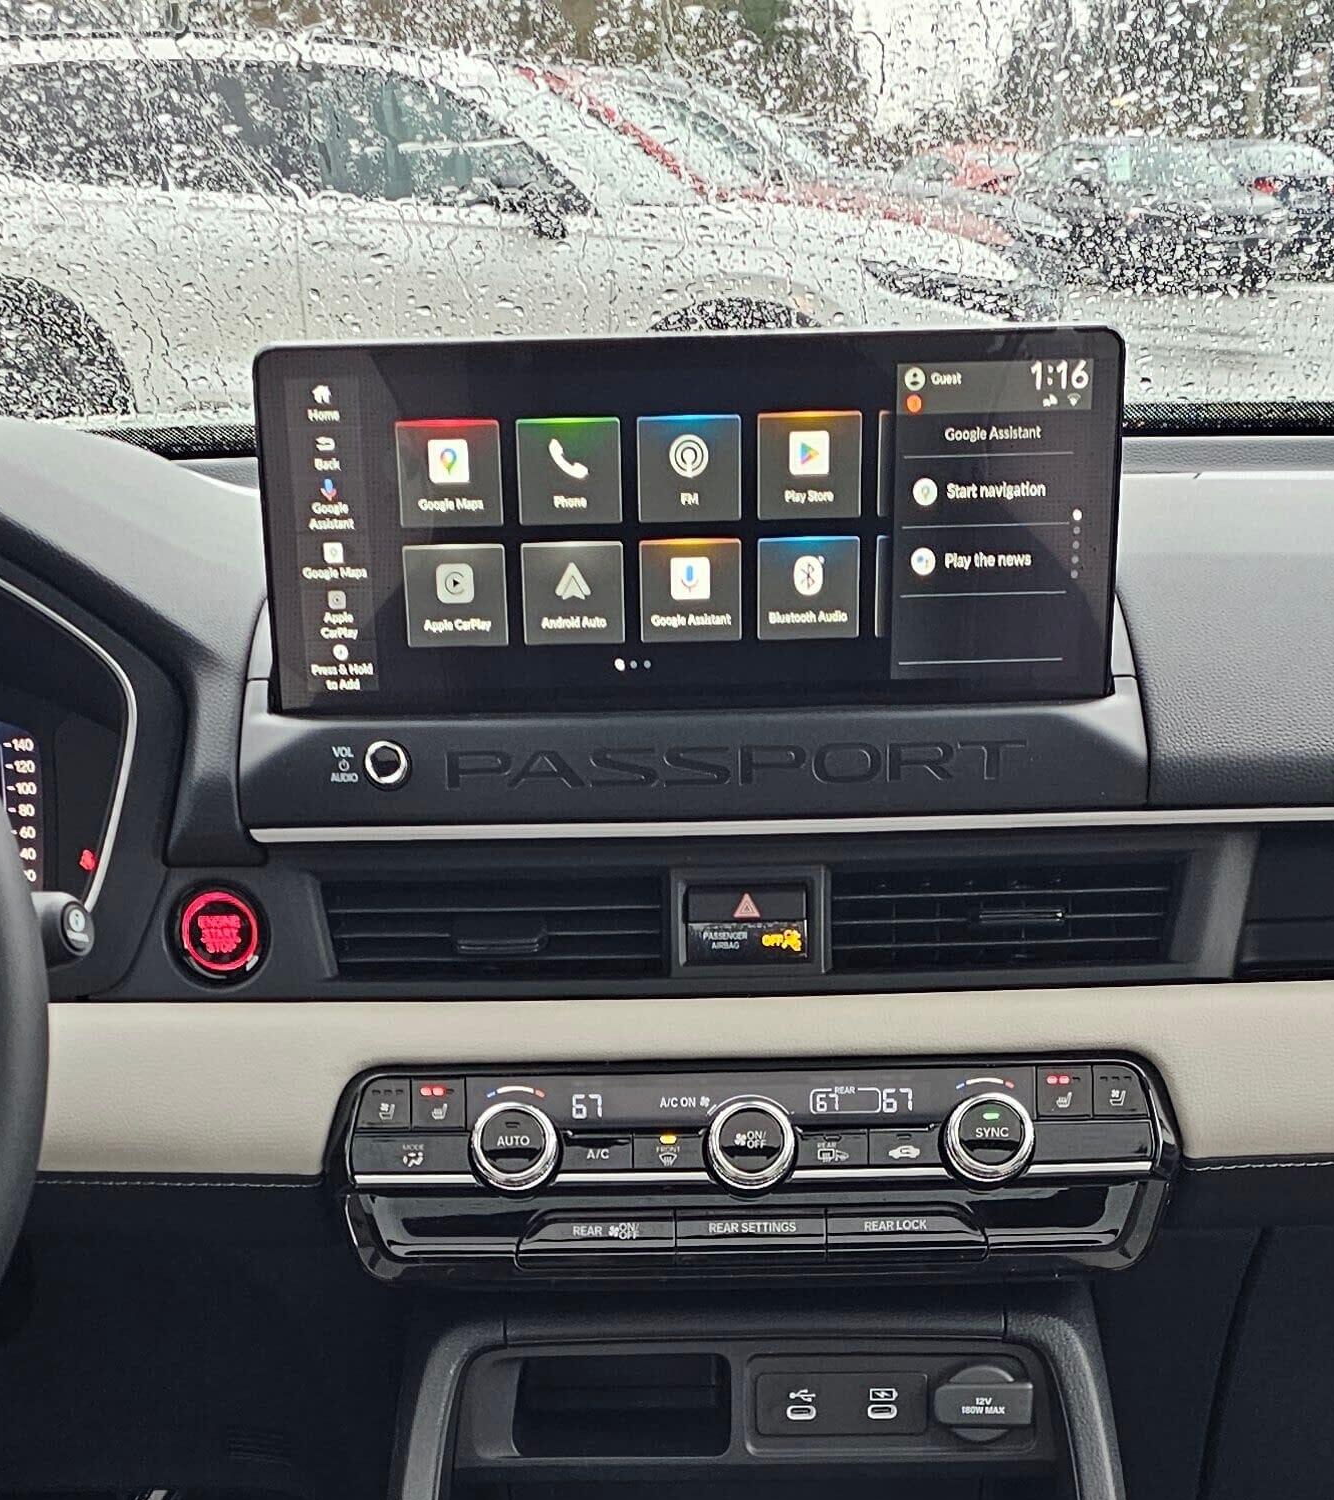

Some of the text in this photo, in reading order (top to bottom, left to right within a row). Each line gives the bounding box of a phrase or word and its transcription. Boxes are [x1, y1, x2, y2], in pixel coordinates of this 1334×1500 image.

[931, 372, 961, 385] Guest
[1031, 359, 1089, 390] 1:16
[307, 409, 340, 422] Home
[945, 426, 1041, 443] Google Assistant
[315, 458, 341, 471] Back
[785, 490, 833, 504] Play Store
[947, 481, 1047, 500] Start navigation
[553, 496, 587, 509] Phone
[681, 492, 699, 506] FM
[311, 502, 349, 515] Google
[418, 499, 484, 513] Google Maps
[309, 517, 355, 530] Assistant
[945, 552, 1031, 570] Play the news
[303, 567, 367, 580] Google Maps
[323, 612, 354, 626] Apple
[541, 616, 607, 629] Android Auto
[651, 612, 731, 628] Google Assistant
[769, 610, 848, 624] Bluetooth Audio
[424, 618, 492, 632] Apple CarPlay
[320, 626, 358, 640] CarPlay
[311, 663, 373, 676] Press & Hold
[326, 679, 361, 690] to Add
[12, 738, 34, 751] 140
[331, 746, 355, 758] VOL
[14, 760, 36, 773] 120
[444, 739, 1028, 791] PASSPORT
[331, 772, 359, 782] AUDIO
[16, 782, 37, 796] 100
[19, 804, 35, 818] 80
[19, 826, 37, 840] 60
[703, 931, 747, 940] PASSENGER
[712, 942, 739, 950] AIRBAG
[571, 1094, 603, 1119] 67
[659, 1096, 696, 1109] A/C ON
[816, 1094, 839, 1112] 67
[883, 1088, 913, 1112] 67
[747, 1130, 767, 1140] ON/
[975, 1127, 1009, 1138] SYNC
[497, 1134, 530, 1147] AUTO
[747, 1139, 767, 1149] OFF
[587, 1148, 609, 1160] A/C
[573, 1222, 639, 1236] REAR ON/
[709, 1221, 797, 1232] REAR SETTINGS
[865, 1219, 927, 1232] REAR LOCK
[619, 1230, 639, 1240] OFF
[974, 1397, 993, 1406] 12V
[961, 1406, 1005, 1415] 180W MAX
